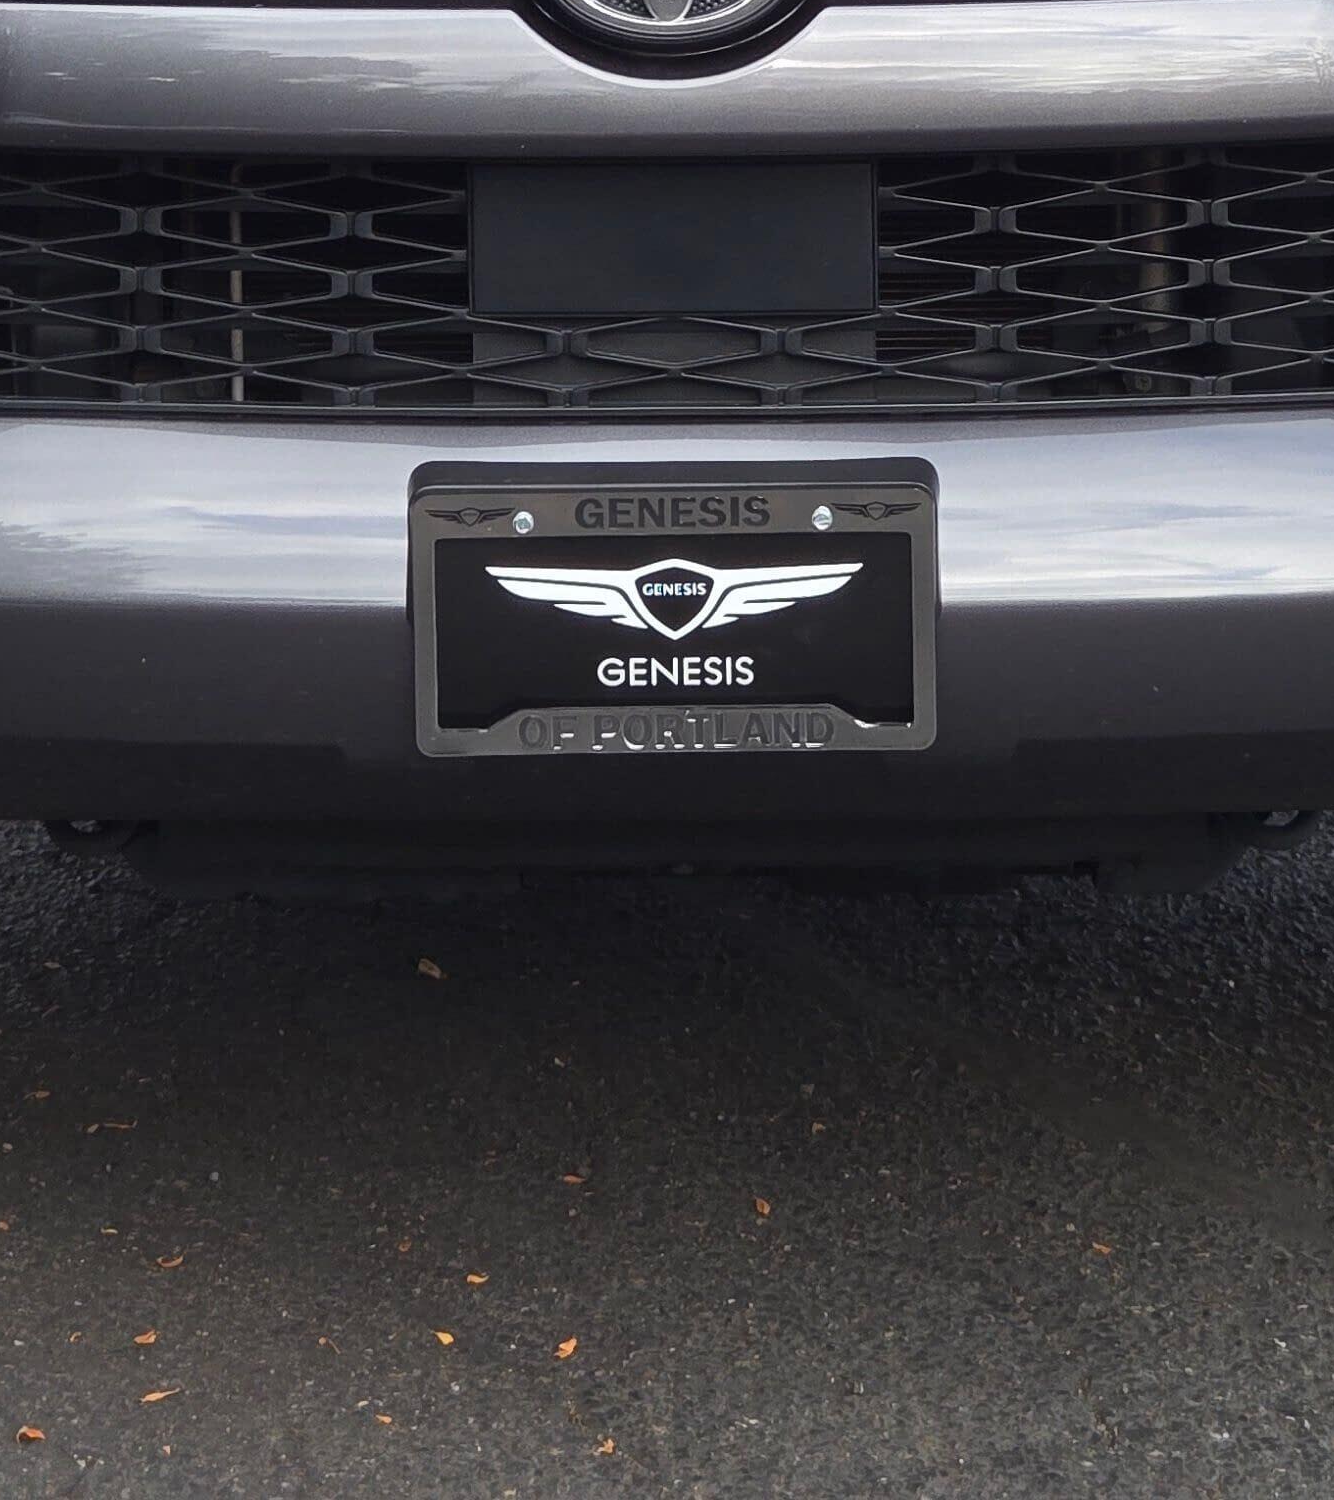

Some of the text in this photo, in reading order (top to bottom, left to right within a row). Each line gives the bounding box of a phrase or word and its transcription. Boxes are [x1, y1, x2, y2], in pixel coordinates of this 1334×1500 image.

[574, 495, 771, 529] GENESIS
[642, 582, 707, 597] GENESIS
[597, 656, 755, 687] GENESIS
[518, 711, 835, 750] OF PORTLAND
